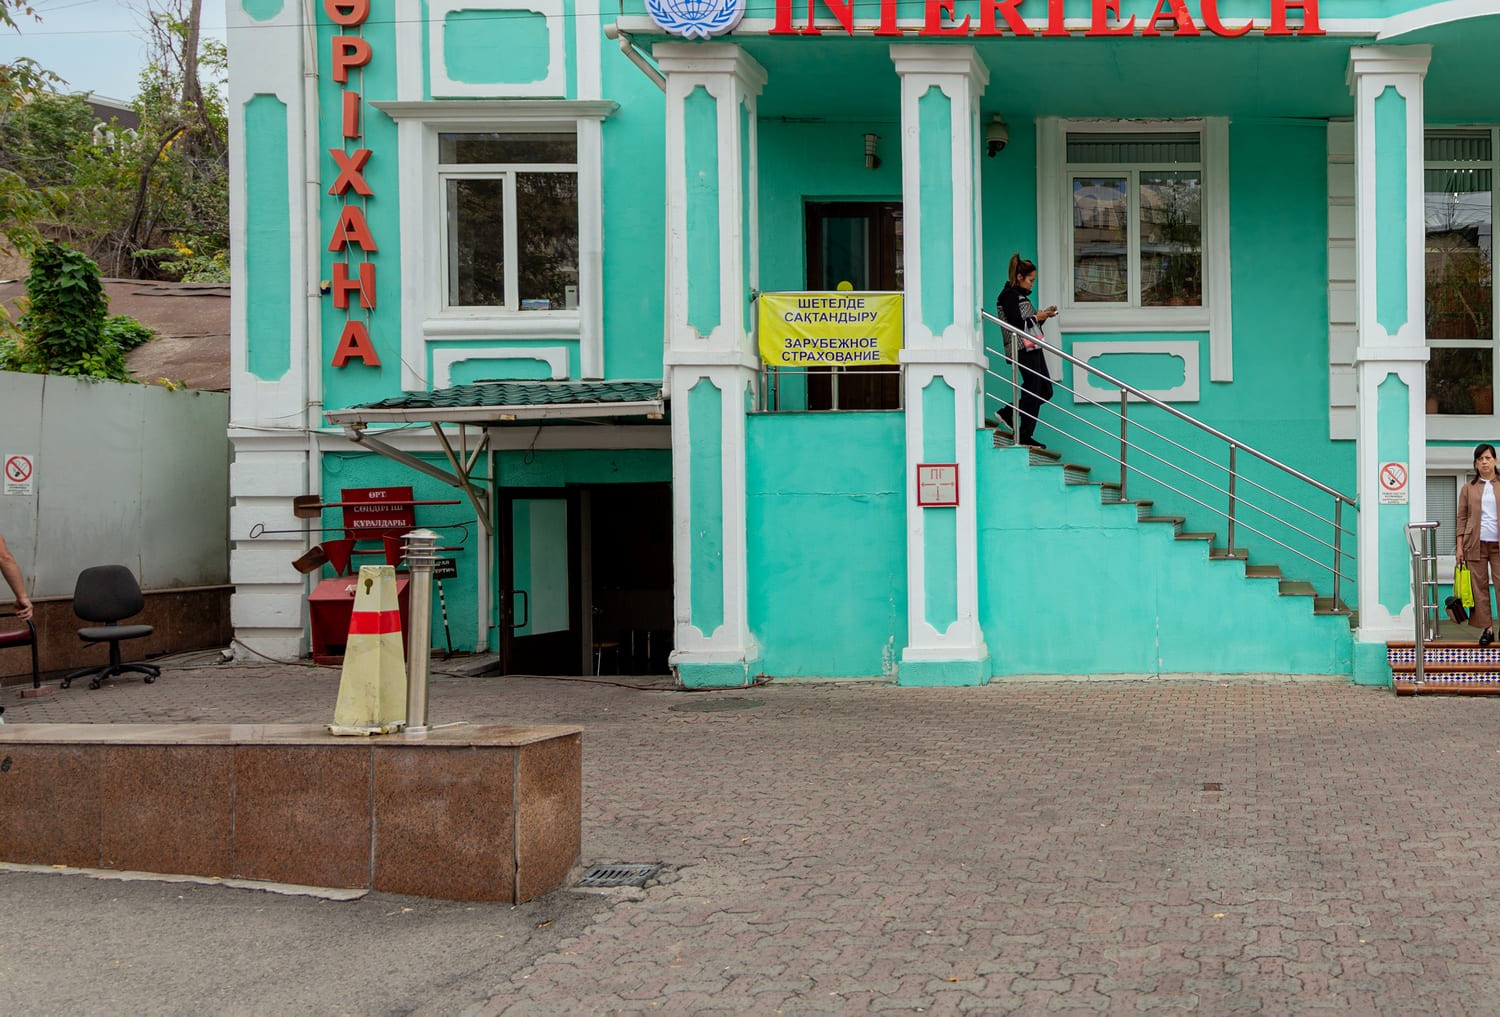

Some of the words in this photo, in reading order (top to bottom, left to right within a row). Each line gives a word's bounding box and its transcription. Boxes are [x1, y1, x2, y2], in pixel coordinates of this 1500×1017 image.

[798, 298, 865, 310] ШЕТЕЛДЕ
[784, 311, 878, 324] САҚТАНДЫРУ
[784, 338, 878, 349] ЗАРУБЕЖНОЕ
[781, 351, 881, 362] СТРАХОВАНИЕ
